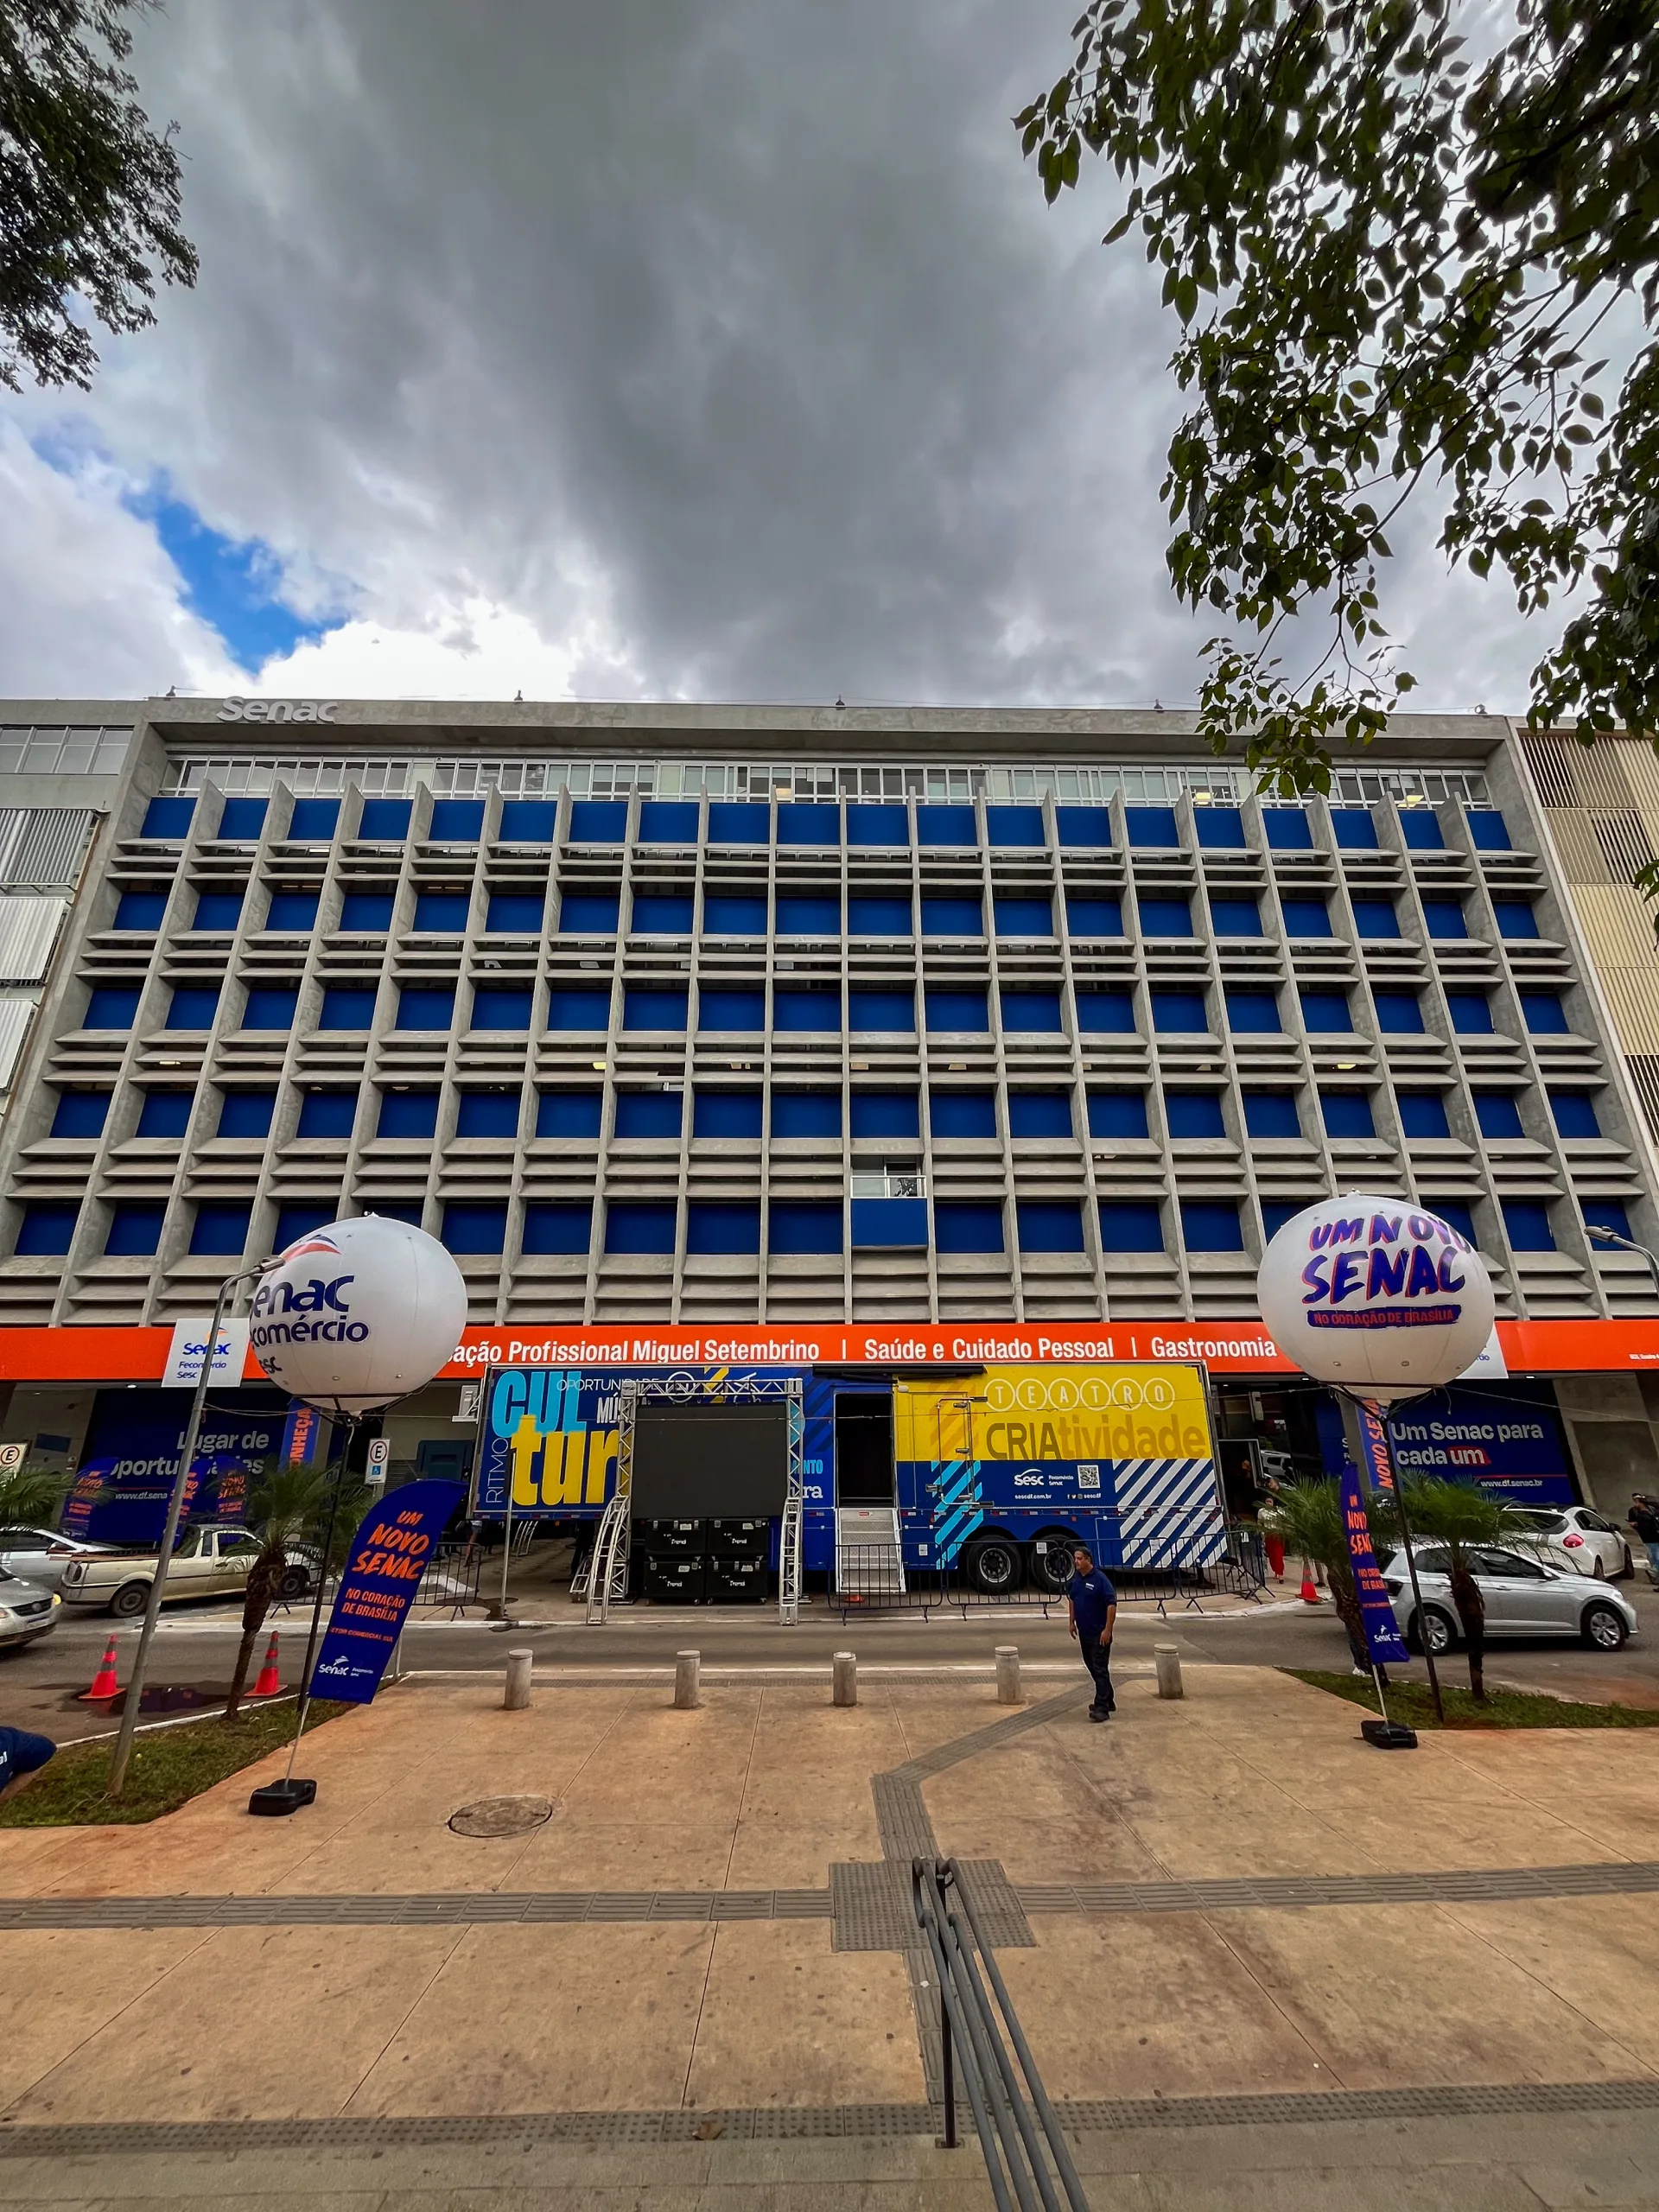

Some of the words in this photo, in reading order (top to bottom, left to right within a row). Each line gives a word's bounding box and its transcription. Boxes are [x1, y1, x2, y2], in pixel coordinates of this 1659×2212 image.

[216, 696, 339, 723] Senac
[1308, 1217, 1365, 1251] UM
[1301, 1244, 1466, 1305] SENAC
[252, 1274, 355, 1319] enac
[1313, 1313, 1330, 1325] NO
[1331, 1310, 1387, 1328] CORAÇÃO
[1387, 1312, 1402, 1324] DE
[1404, 1307, 1455, 1324] BRASÍLIA
[251, 1314, 370, 1348] comércio
[448, 1340, 502, 1368] ação
[508, 1340, 628, 1363] Profissional
[632, 1339, 700, 1363] Miguel
[704, 1338, 820, 1361] Setembrino
[864, 1338, 926, 1360] Saúde
[932, 1343, 944, 1359] e
[952, 1338, 1033, 1359] Cuidado
[1039, 1337, 1114, 1358] Pessoal
[1151, 1336, 1278, 1358] Gastronomia
[176, 1370, 198, 1379] Sesc
[491, 1370, 588, 1440] CUL
[993, 1382, 1166, 1406] TEATRO
[241, 1430, 270, 1450] de
[986, 1414, 1206, 1460] CRIAtividade
[1391, 1421, 1427, 1441] Um
[1430, 1421, 1495, 1440] Senac
[1497, 1423, 1544, 1443] para
[374, 1445, 383, 1459] E
[1396, 1446, 1448, 1465] cada
[1450, 1449, 1486, 1465] um
[485, 1438, 509, 1504] RITMO
[1014, 1473, 1045, 1486] Sesc
[396, 1510, 424, 1526] UM
[366, 1522, 429, 1555] NOVO
[351, 1549, 425, 1580] SENAC
[345, 1587, 361, 1600] NO
[361, 1590, 406, 1610] CORAÇÃO
[341, 1601, 357, 1615] DE
[356, 1604, 399, 1623] BRASÍLIA
[318, 1663, 350, 1676] Senac
